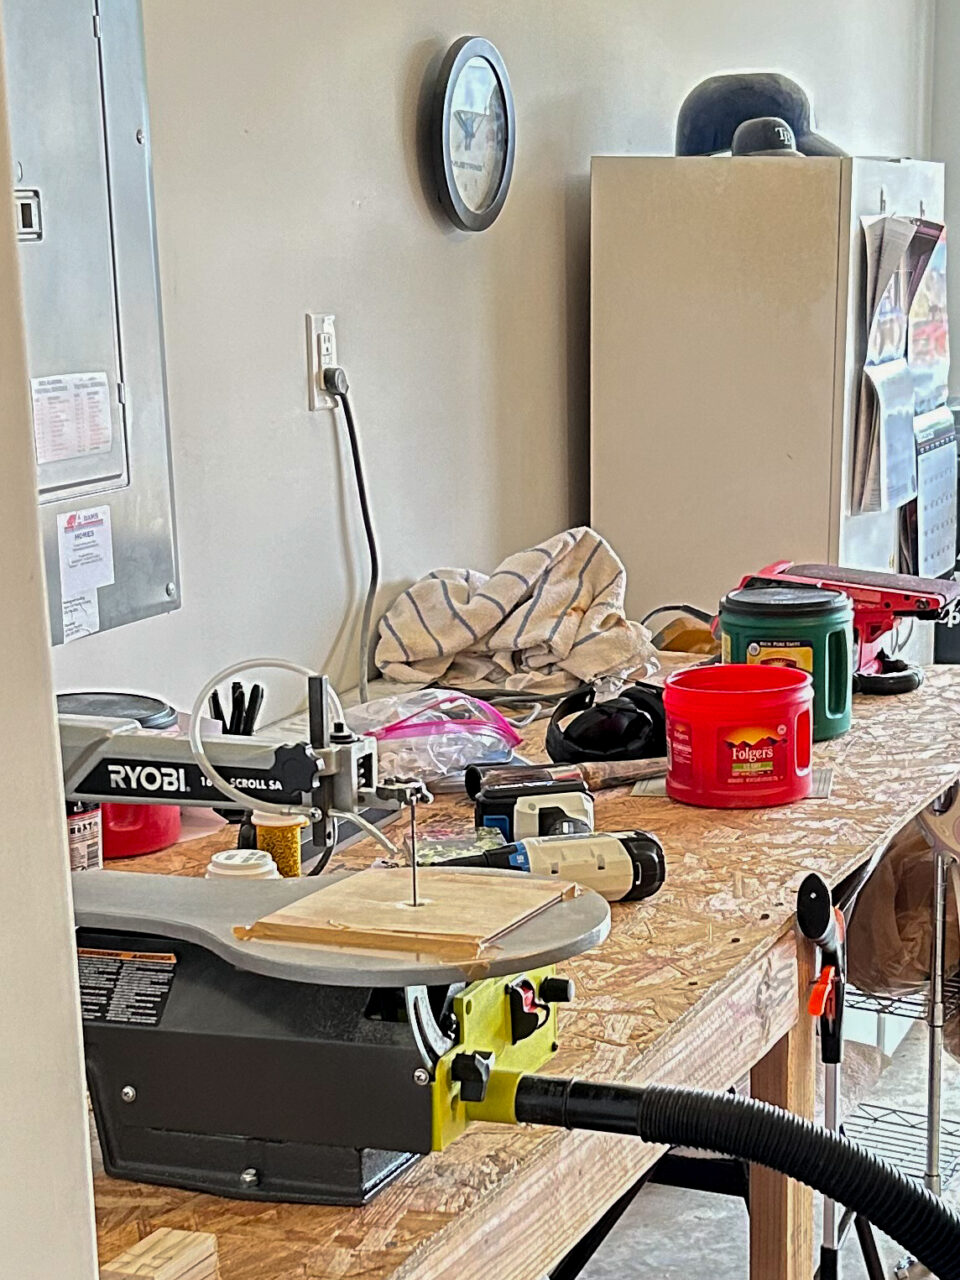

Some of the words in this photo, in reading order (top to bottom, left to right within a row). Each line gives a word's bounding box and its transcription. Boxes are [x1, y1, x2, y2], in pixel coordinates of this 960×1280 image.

[732, 747, 774, 763] Folgers
[107, 764, 187, 792] RYOBI
[230, 778, 267, 789] SCROLL
[268, 780, 283, 791] SA
